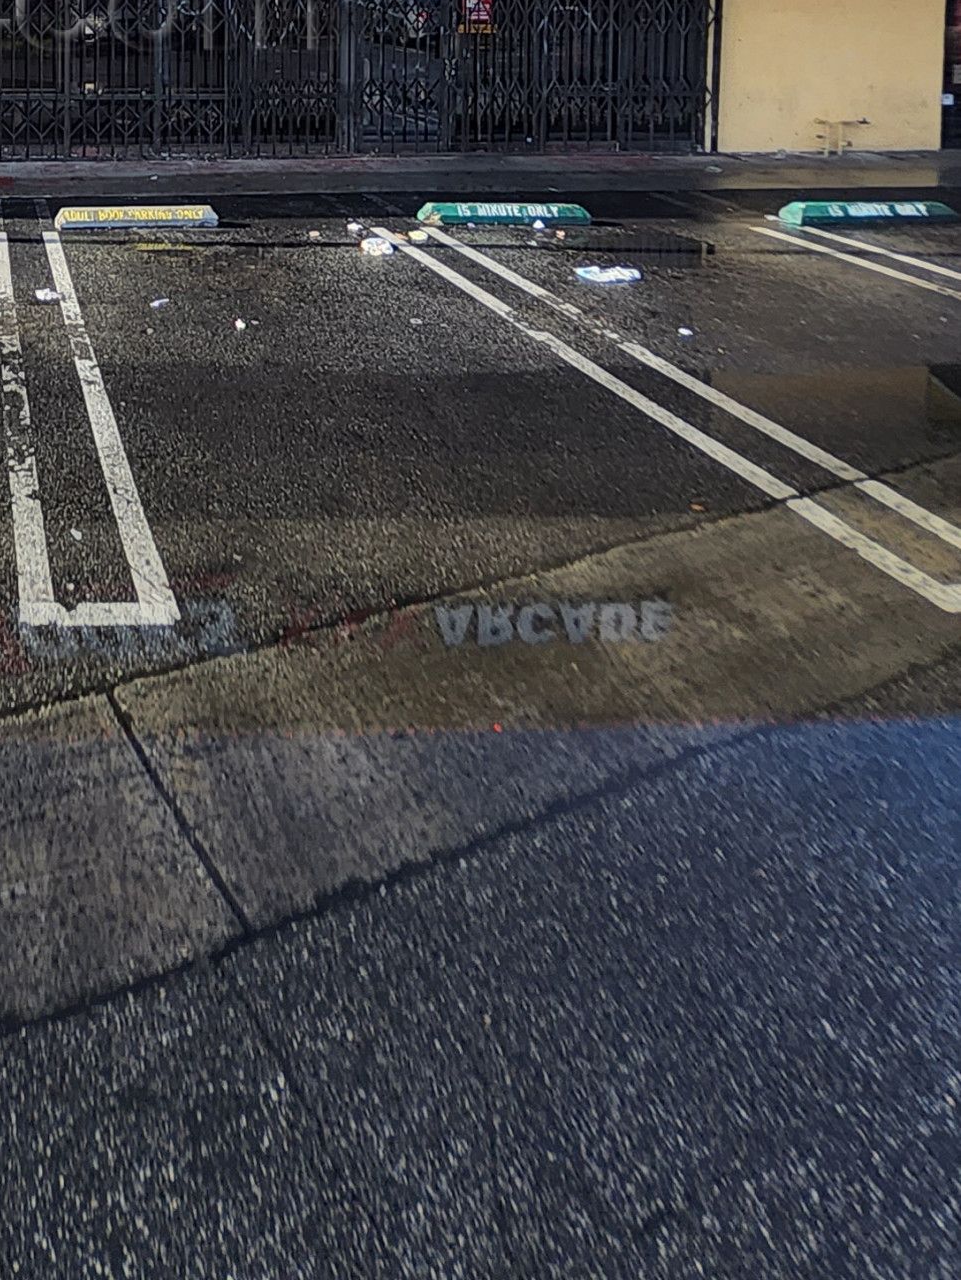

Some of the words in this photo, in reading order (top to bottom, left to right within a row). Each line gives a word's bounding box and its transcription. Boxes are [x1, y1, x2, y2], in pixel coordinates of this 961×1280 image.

[176, 208, 204, 220] ONLY
[477, 205, 522, 217] MINUTE
[528, 205, 559, 218] ONLY
